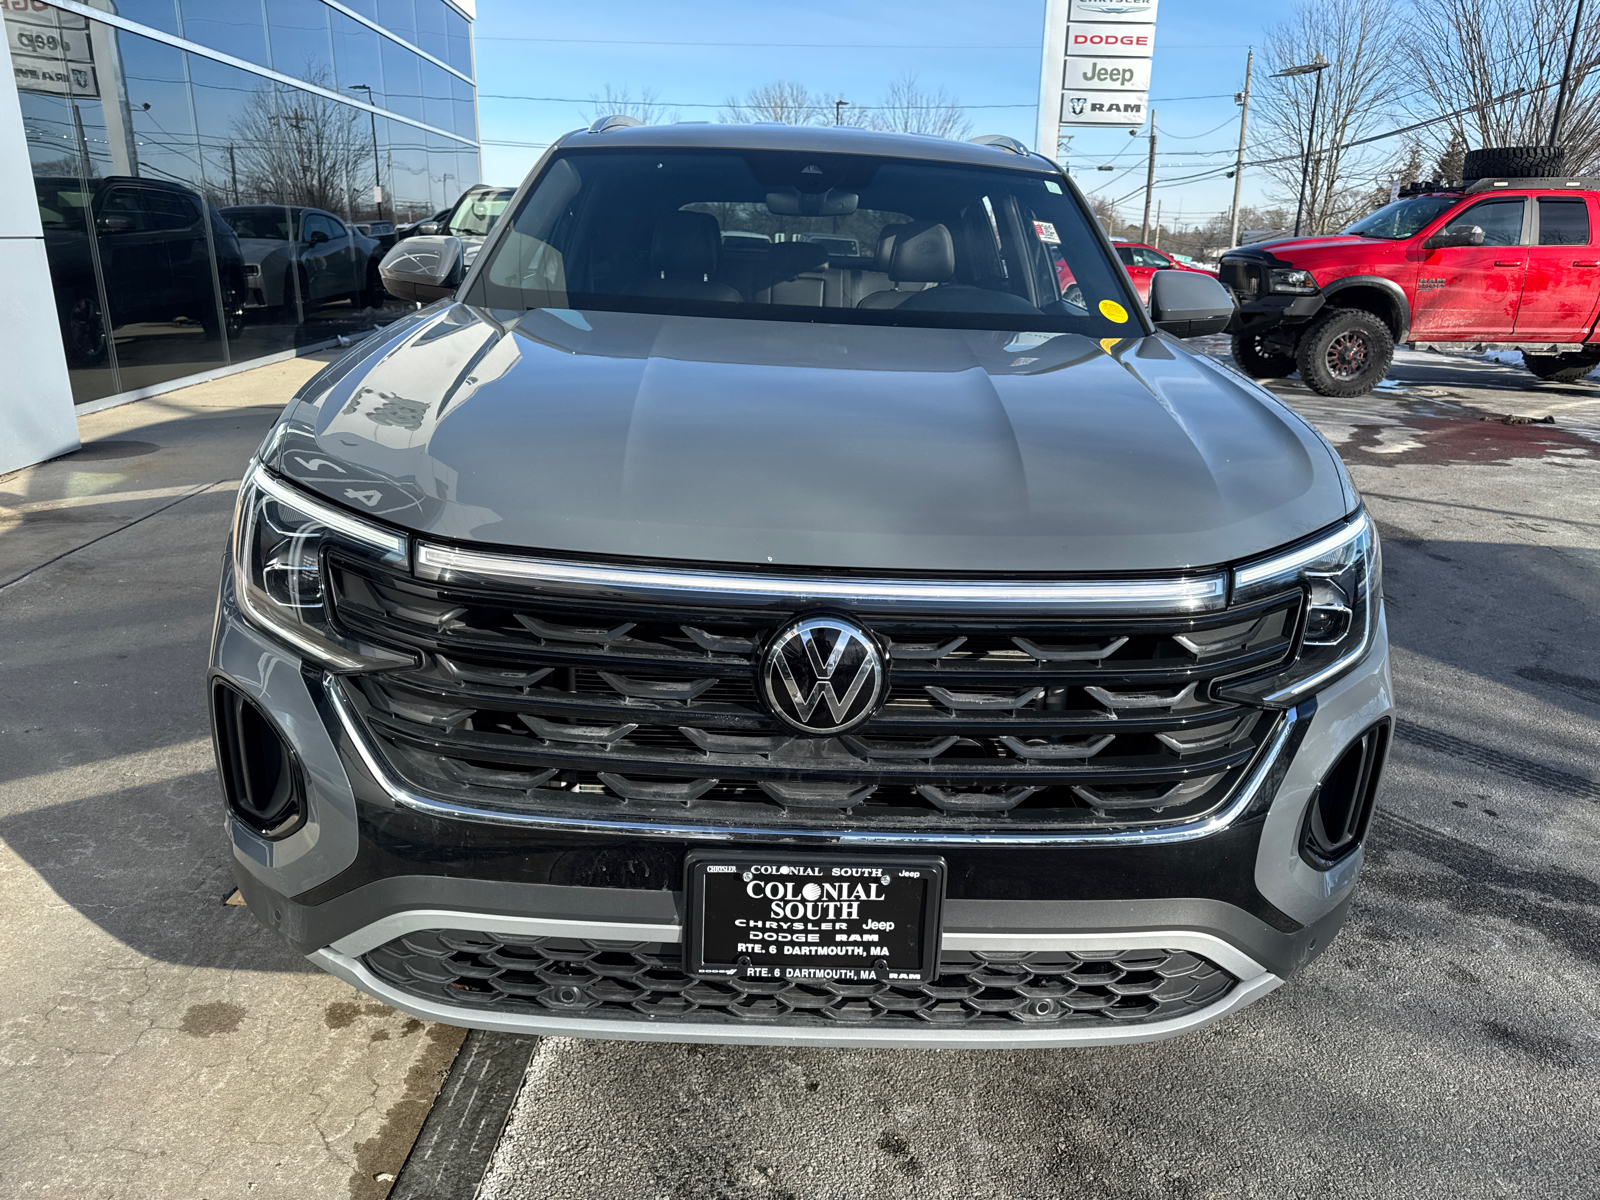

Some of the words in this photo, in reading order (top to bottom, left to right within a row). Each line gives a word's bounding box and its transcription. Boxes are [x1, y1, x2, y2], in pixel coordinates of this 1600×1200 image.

[1074, 35, 1148, 46] DODGE
[1082, 62, 1134, 86] Jeep
[1090, 103, 1141, 113] RAM
[751, 865, 823, 876] COLONIAL
[832, 868, 882, 877] SOUTH
[899, 870, 920, 878] Jeep
[746, 880, 885, 901] COLONIAL
[770, 901, 860, 920] SOUTH
[734, 919, 848, 930] CHRYSLER
[863, 919, 895, 932] Jeep
[750, 931, 819, 942] DODGE
[835, 934, 879, 942] RAM
[738, 943, 765, 954] RTE.
[770, 945, 777, 954] 6
[783, 946, 866, 957] DARTMOUTH,
[870, 947, 889, 956] MA
[747, 968, 771, 977] RTE.
[774, 968, 780, 977] 6
[786, 969, 857, 980] DARTMOUTH,
[861, 970, 876, 979] MA
